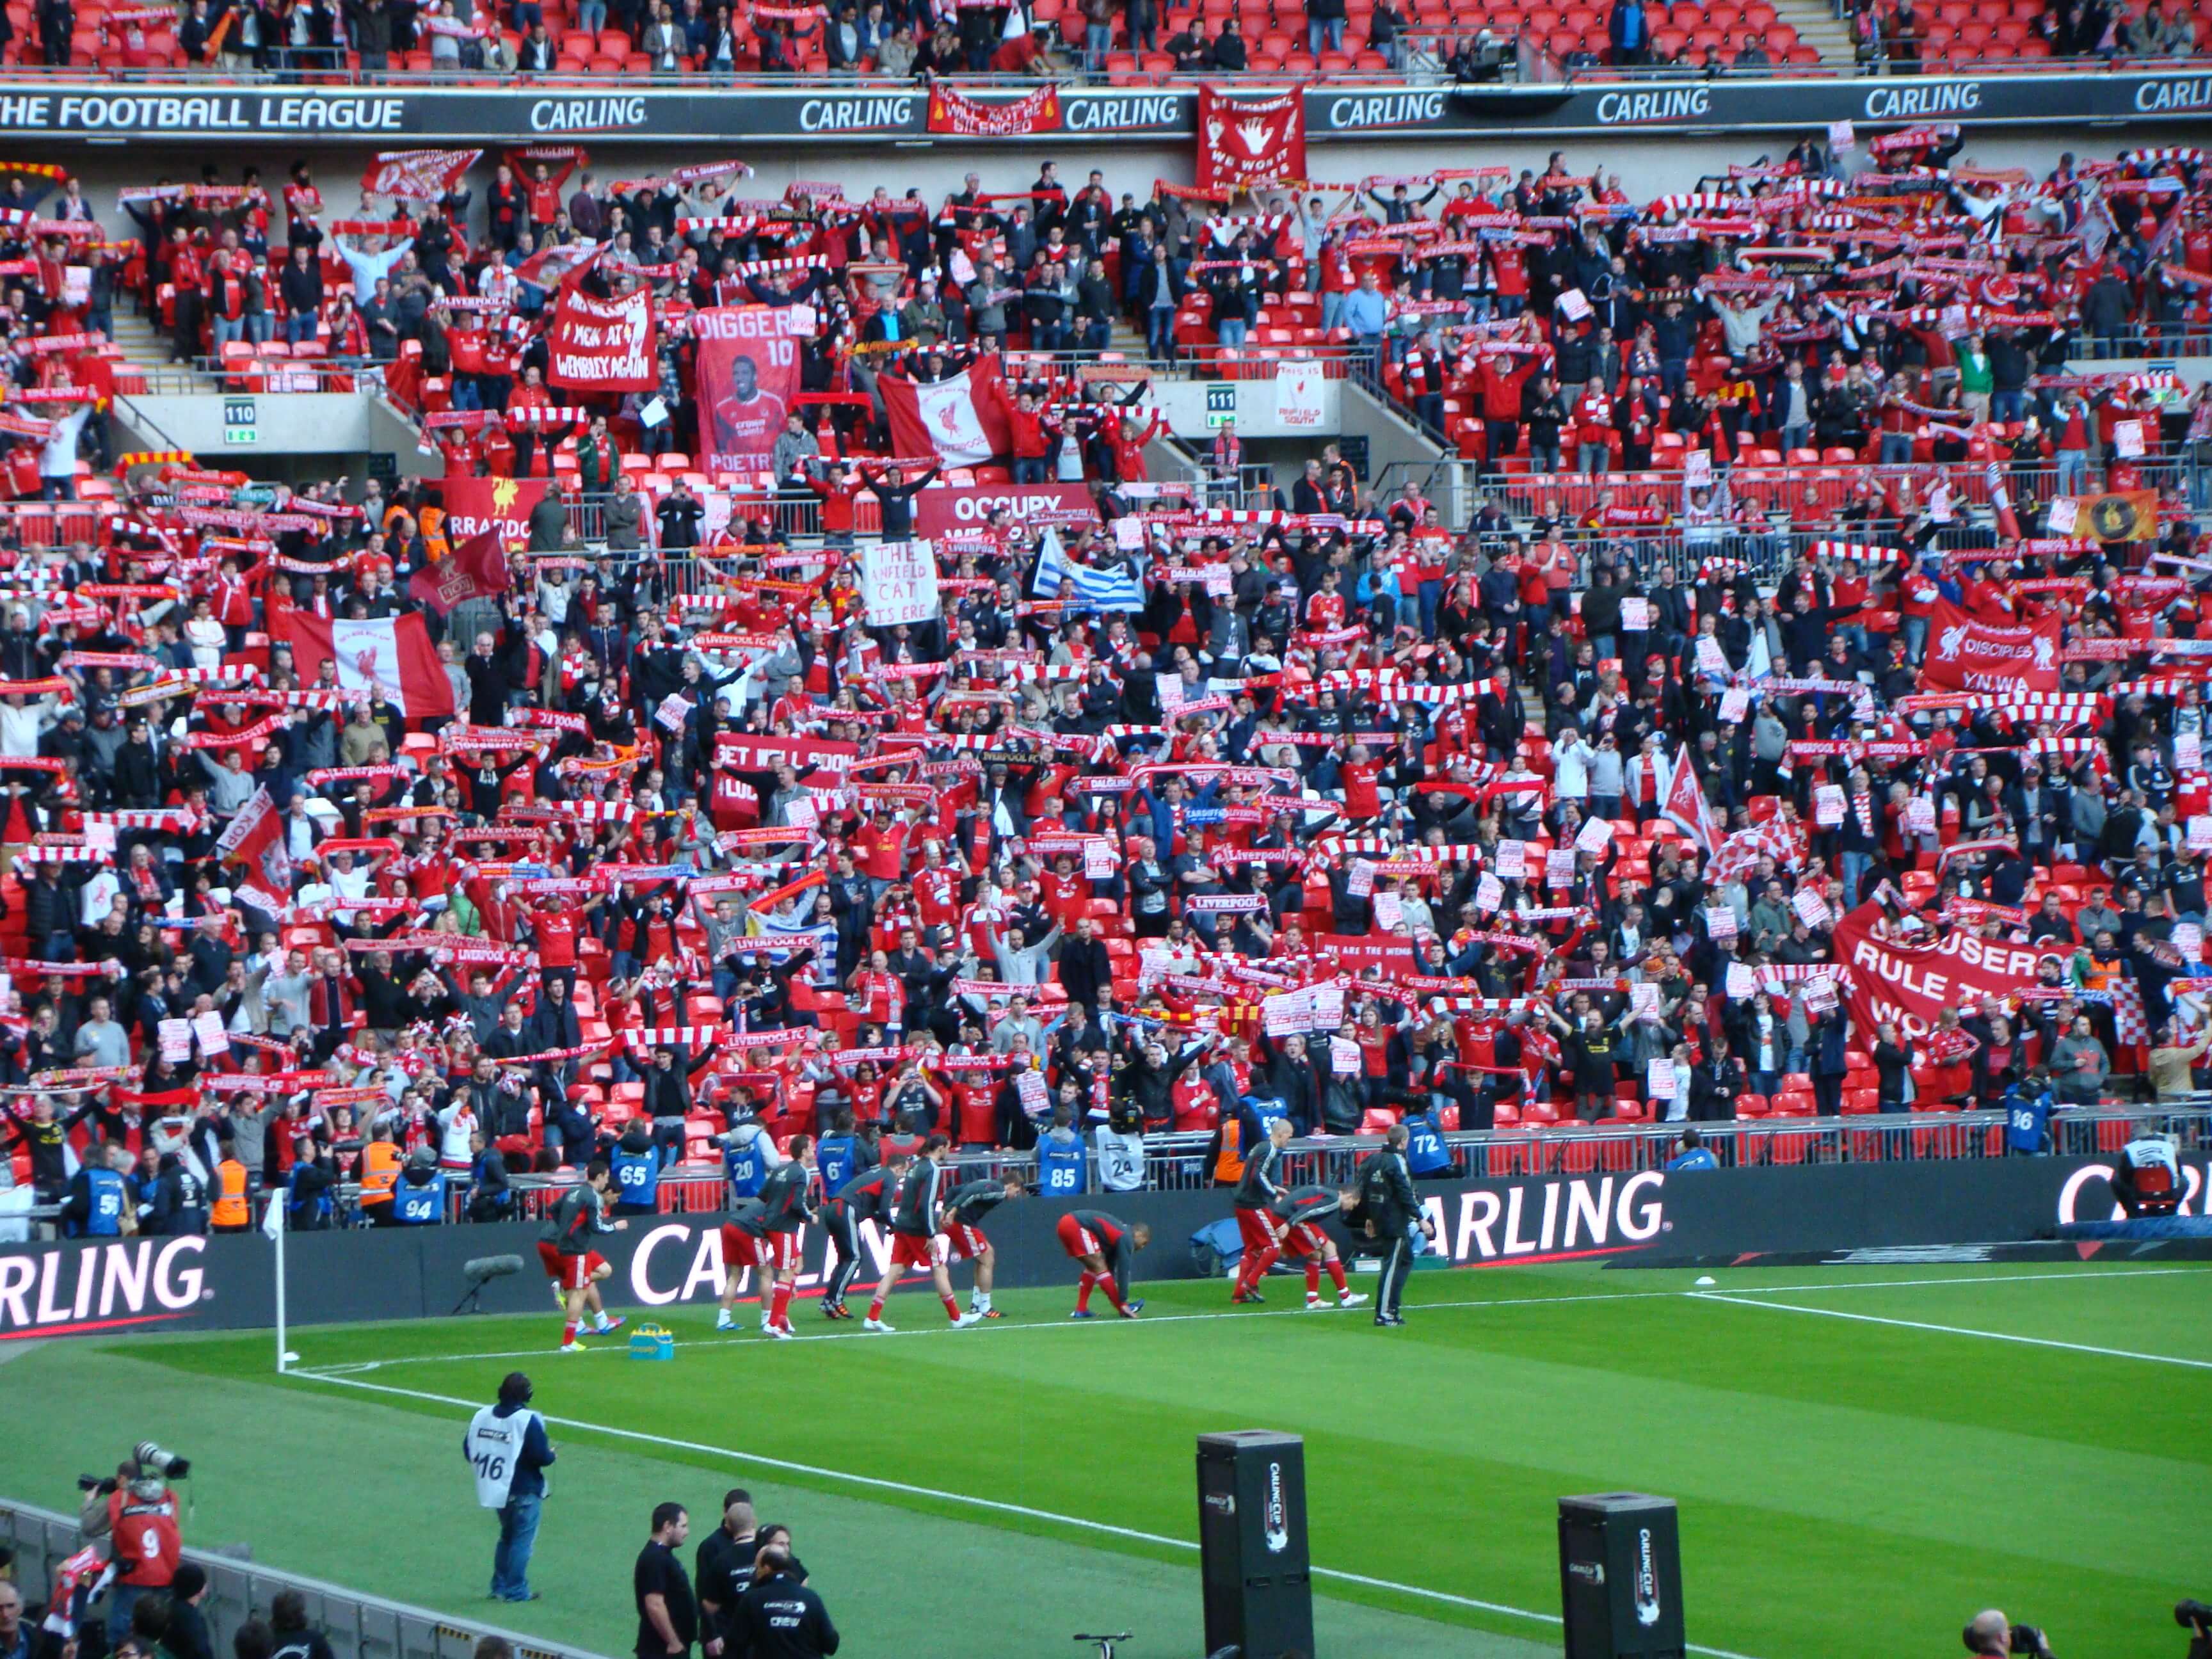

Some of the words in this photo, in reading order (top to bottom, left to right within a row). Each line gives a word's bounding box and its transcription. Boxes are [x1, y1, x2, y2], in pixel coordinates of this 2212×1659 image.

[1331, 92, 1443, 128] CARLING
[1598, 88, 1709, 123] CARLING
[1866, 83, 1980, 118] CARLING
[60, 97, 250, 127] FOOTBALL
[260, 98, 405, 128] LEAGUE
[531, 97, 645, 132] CARLING
[800, 97, 912, 132] CARLING
[1066, 96, 1178, 131] CARLING
[954, 119, 1032, 136] SILENCED
[695, 310, 790, 340] DIGGER
[767, 340, 794, 367] 10
[557, 353, 610, 379] WEMBLEY
[611, 355, 649, 379] AGAIN
[1208, 393, 1235, 408] 111
[225, 405, 255, 422] 110
[710, 453, 773, 472] POETR
[955, 495, 1062, 521] OCCUPY
[874, 543, 918, 563] THE
[871, 564, 927, 581] ANFIELD
[878, 582, 917, 601] CAT
[874, 607, 895, 624] IS
[901, 604, 926, 620] ERE
[1965, 637, 2033, 659] DISCIPLES
[1229, 849, 1285, 862] Liverpool
[527, 879, 577, 892] LIVERPOOL
[1196, 896, 1261, 908] LIVERPOOL
[737, 936, 795, 950] LIVERPOOL
[796, 936, 812, 947] FC
[1342, 946, 1360, 955] ARE
[1365, 946, 1382, 956] THE
[458, 948, 504, 962] LIVERPOOL
[509, 950, 520, 964] FC
[1854, 940, 1950, 1002] RULE
[728, 1030, 790, 1047] LIVERPOOL
[791, 1027, 806, 1041] FC
[833, 1048, 886, 1061] LIVERPOOL
[888, 1046, 901, 1057] FC
[945, 1055, 991, 1066] LIVERPOOL
[995, 1054, 1008, 1066] FC
[1413, 1134, 1439, 1153] 72
[620, 1165, 646, 1186] 65
[733, 1160, 753, 1180] 20
[1051, 1167, 1076, 1188] 85
[1112, 1159, 1134, 1177] 24
[406, 1199, 432, 1219] 94
[1422, 1170, 1664, 1261] ARLING
[1270, 1463, 1281, 1503] CARLING
[1272, 1503, 1282, 1524] CUP
[141, 1528, 159, 1558] 9
[1639, 1528, 1652, 1573] CARLING
[1643, 1573, 1653, 1595] CUP
[770, 1616, 801, 1628] CREW
